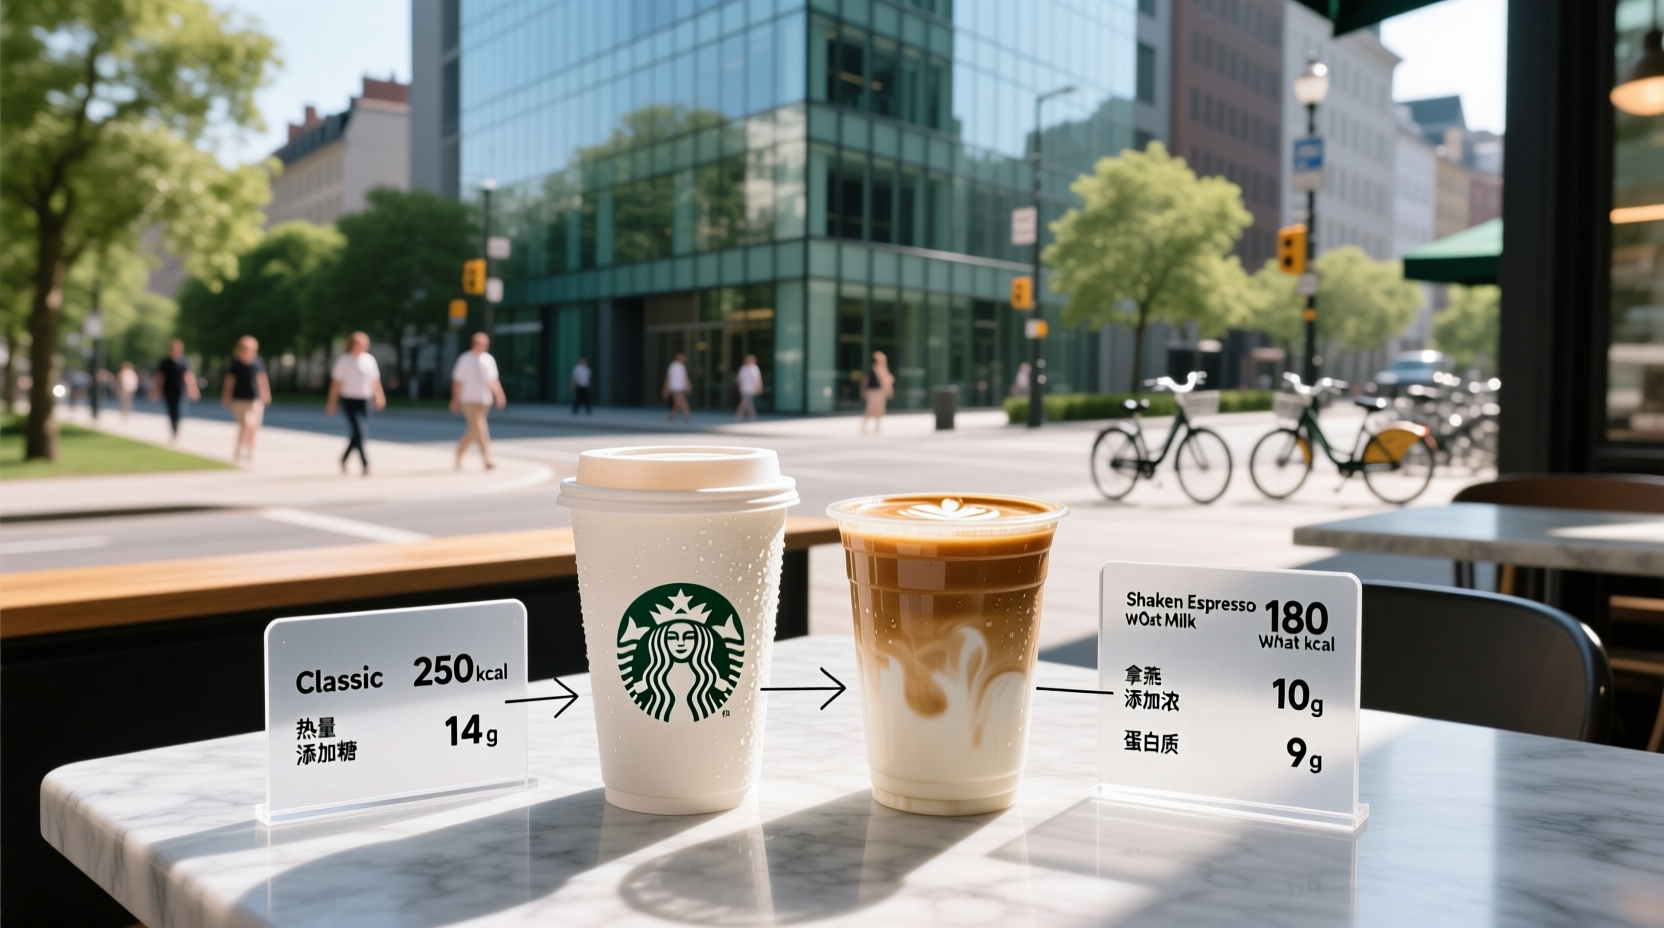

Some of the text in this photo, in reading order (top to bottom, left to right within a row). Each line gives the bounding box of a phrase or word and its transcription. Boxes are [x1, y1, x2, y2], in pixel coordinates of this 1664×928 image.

[1126, 591, 1257, 614] Shaken Espresso
[1165, 612, 1197, 629] Milk
[1265, 599, 1329, 635] 180
[1305, 635, 1335, 652] kcal
[296, 665, 384, 694] Classic
[296, 716, 336, 740] 热量
[296, 740, 358, 766] 添加糖
[1123, 729, 1179, 755] 蛋白质
